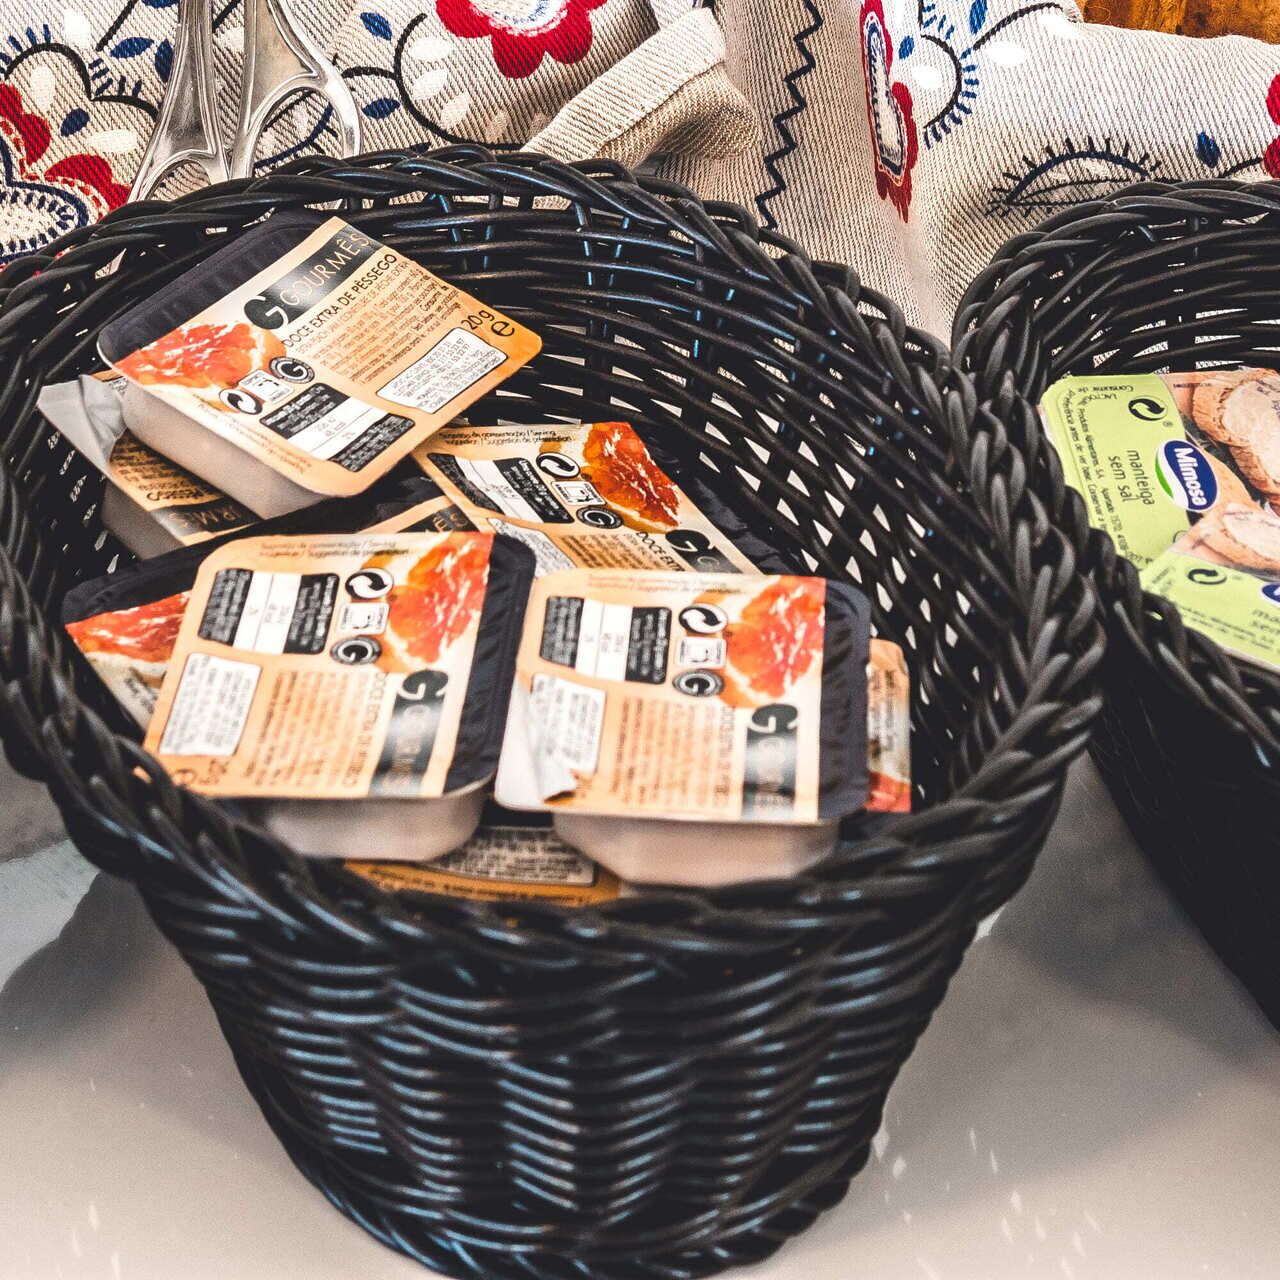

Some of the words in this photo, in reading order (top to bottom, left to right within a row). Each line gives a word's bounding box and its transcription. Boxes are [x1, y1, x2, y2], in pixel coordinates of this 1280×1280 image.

[280, 227, 369, 308] GOURMÊS
[282, 322, 312, 349] DOCE
[310, 300, 339, 327] EXTRA
[337, 288, 354, 305] DE
[1108, 455, 1125, 480] sem
[1118, 484, 1136, 502] sal
[1125, 449, 1155, 505] manteiga
[1173, 446, 1209, 507] Mimosa
[636, 529, 666, 554] DOCE
[658, 552, 685, 574] EXTR
